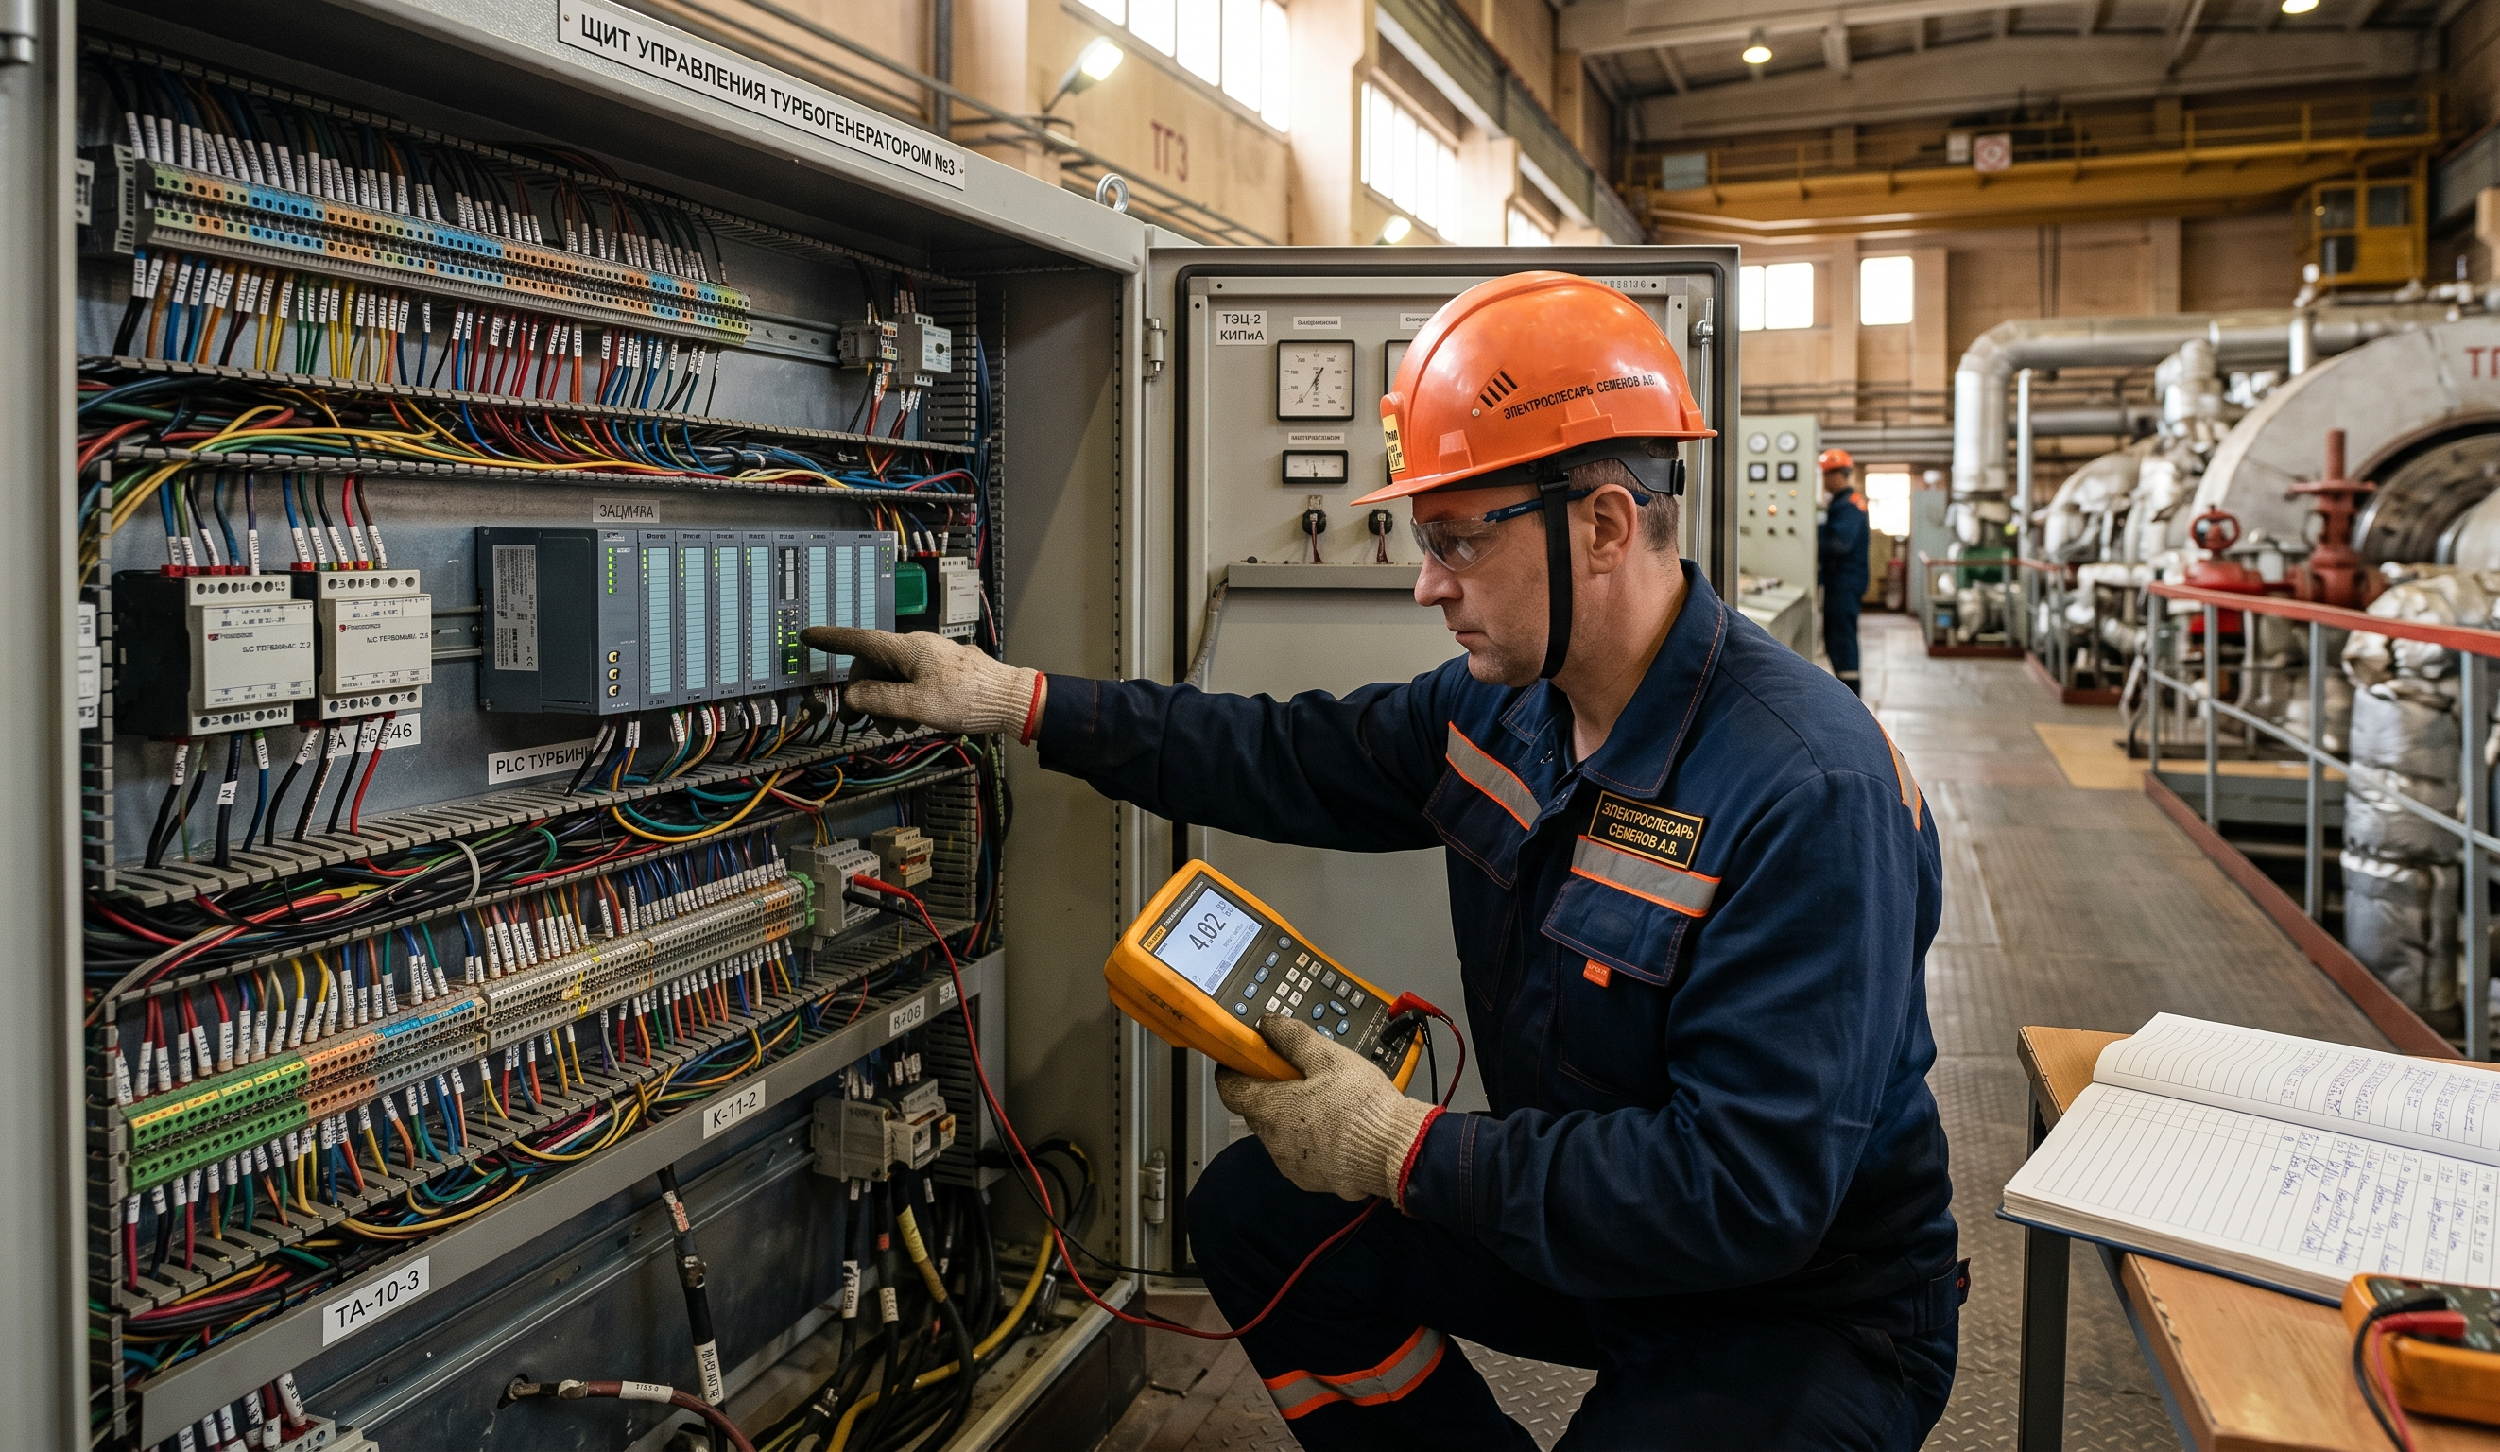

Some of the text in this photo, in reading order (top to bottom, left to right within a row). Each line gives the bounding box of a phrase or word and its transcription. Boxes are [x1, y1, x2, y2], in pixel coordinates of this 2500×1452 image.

[581, 13, 956, 176] ЩИТ УПРАВЛЕНИЯ ТУРБОГЕНЕРАТОРОМ №3
[1222, 314, 1261, 324] ТЭЦ-2
[1220, 330, 1264, 340] КИПиА
[496, 756, 525, 774] PLC
